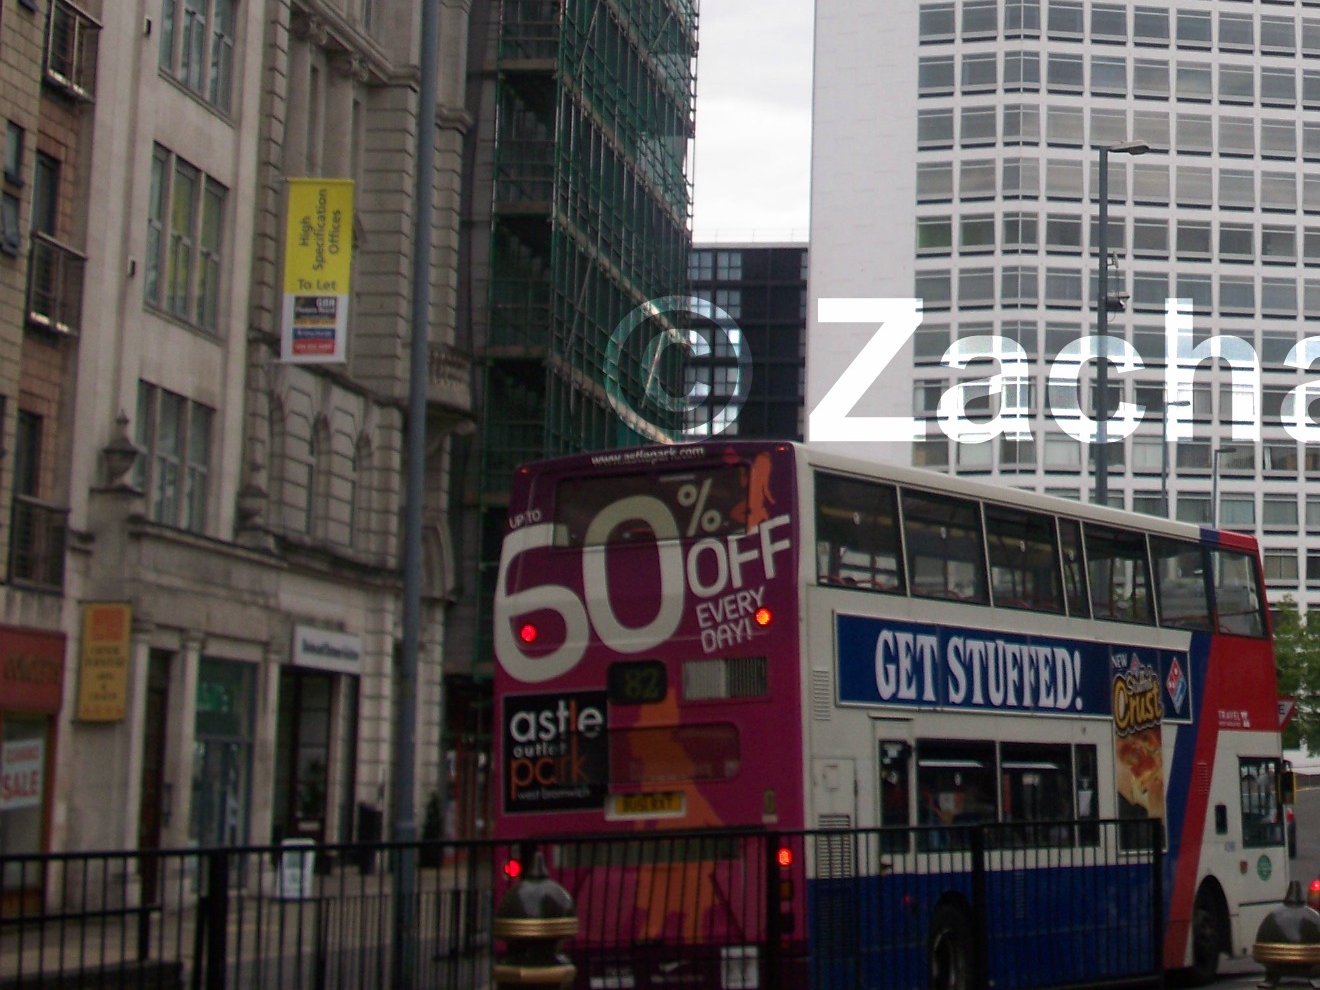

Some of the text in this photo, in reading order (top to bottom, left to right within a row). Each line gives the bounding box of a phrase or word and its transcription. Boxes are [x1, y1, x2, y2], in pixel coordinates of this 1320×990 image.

[300, 216, 313, 247] High
[312, 189, 328, 271] Specification
[328, 210, 342, 255] Offices
[297, 279, 337, 290] To Let
[509, 510, 541, 529] UP TO
[687, 515, 791, 598] OFF
[695, 587, 765, 630] EVERY
[700, 616, 752, 655] DAY!
[875, 629, 938, 702] GET
[947, 636, 1084, 710] STUFFED!
[1111, 654, 1127, 668] NEW
[624, 668, 660, 700] 82
[1113, 674, 1163, 727] Crust
[510, 699, 604, 742] astle
[1218, 710, 1240, 719] TRAVEL
[513, 742, 568, 758] outlet
[1, 770, 39, 801] SALE
[510, 756, 591, 801] park
[517, 789, 541, 800] west
